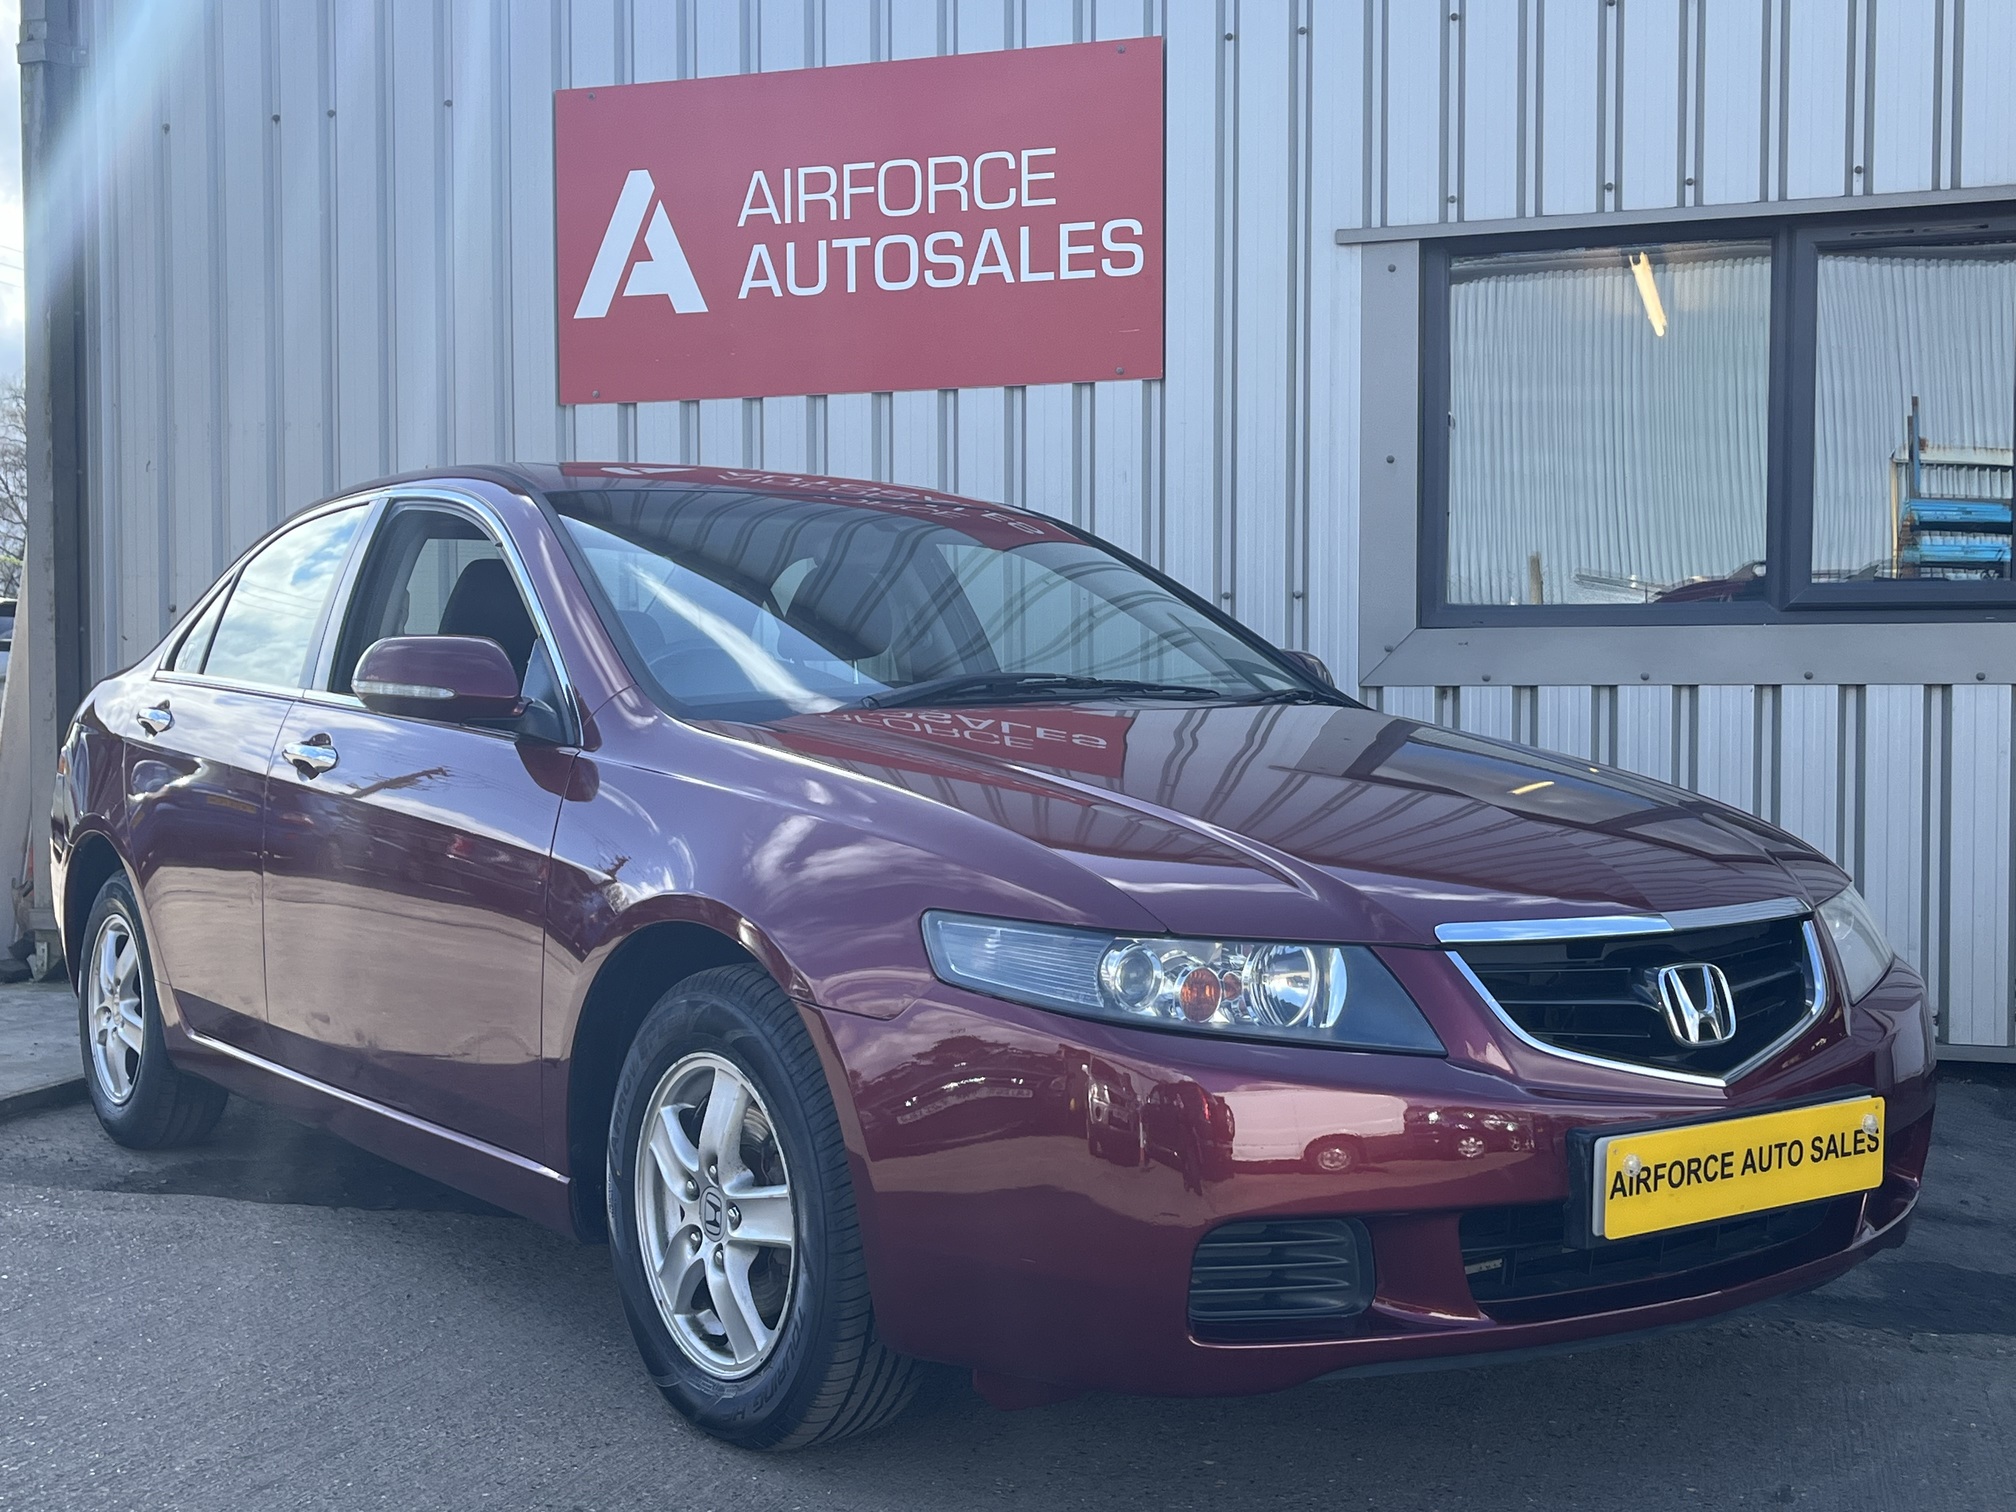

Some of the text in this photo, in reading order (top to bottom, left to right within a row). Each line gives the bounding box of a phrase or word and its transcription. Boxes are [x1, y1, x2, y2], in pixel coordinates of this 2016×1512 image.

[737, 147, 1057, 227] AIRFORCE
[737, 218, 1144, 300] AUTOSALES
[1609, 1128, 1880, 1200] AIRFORCE AUTO SALES
